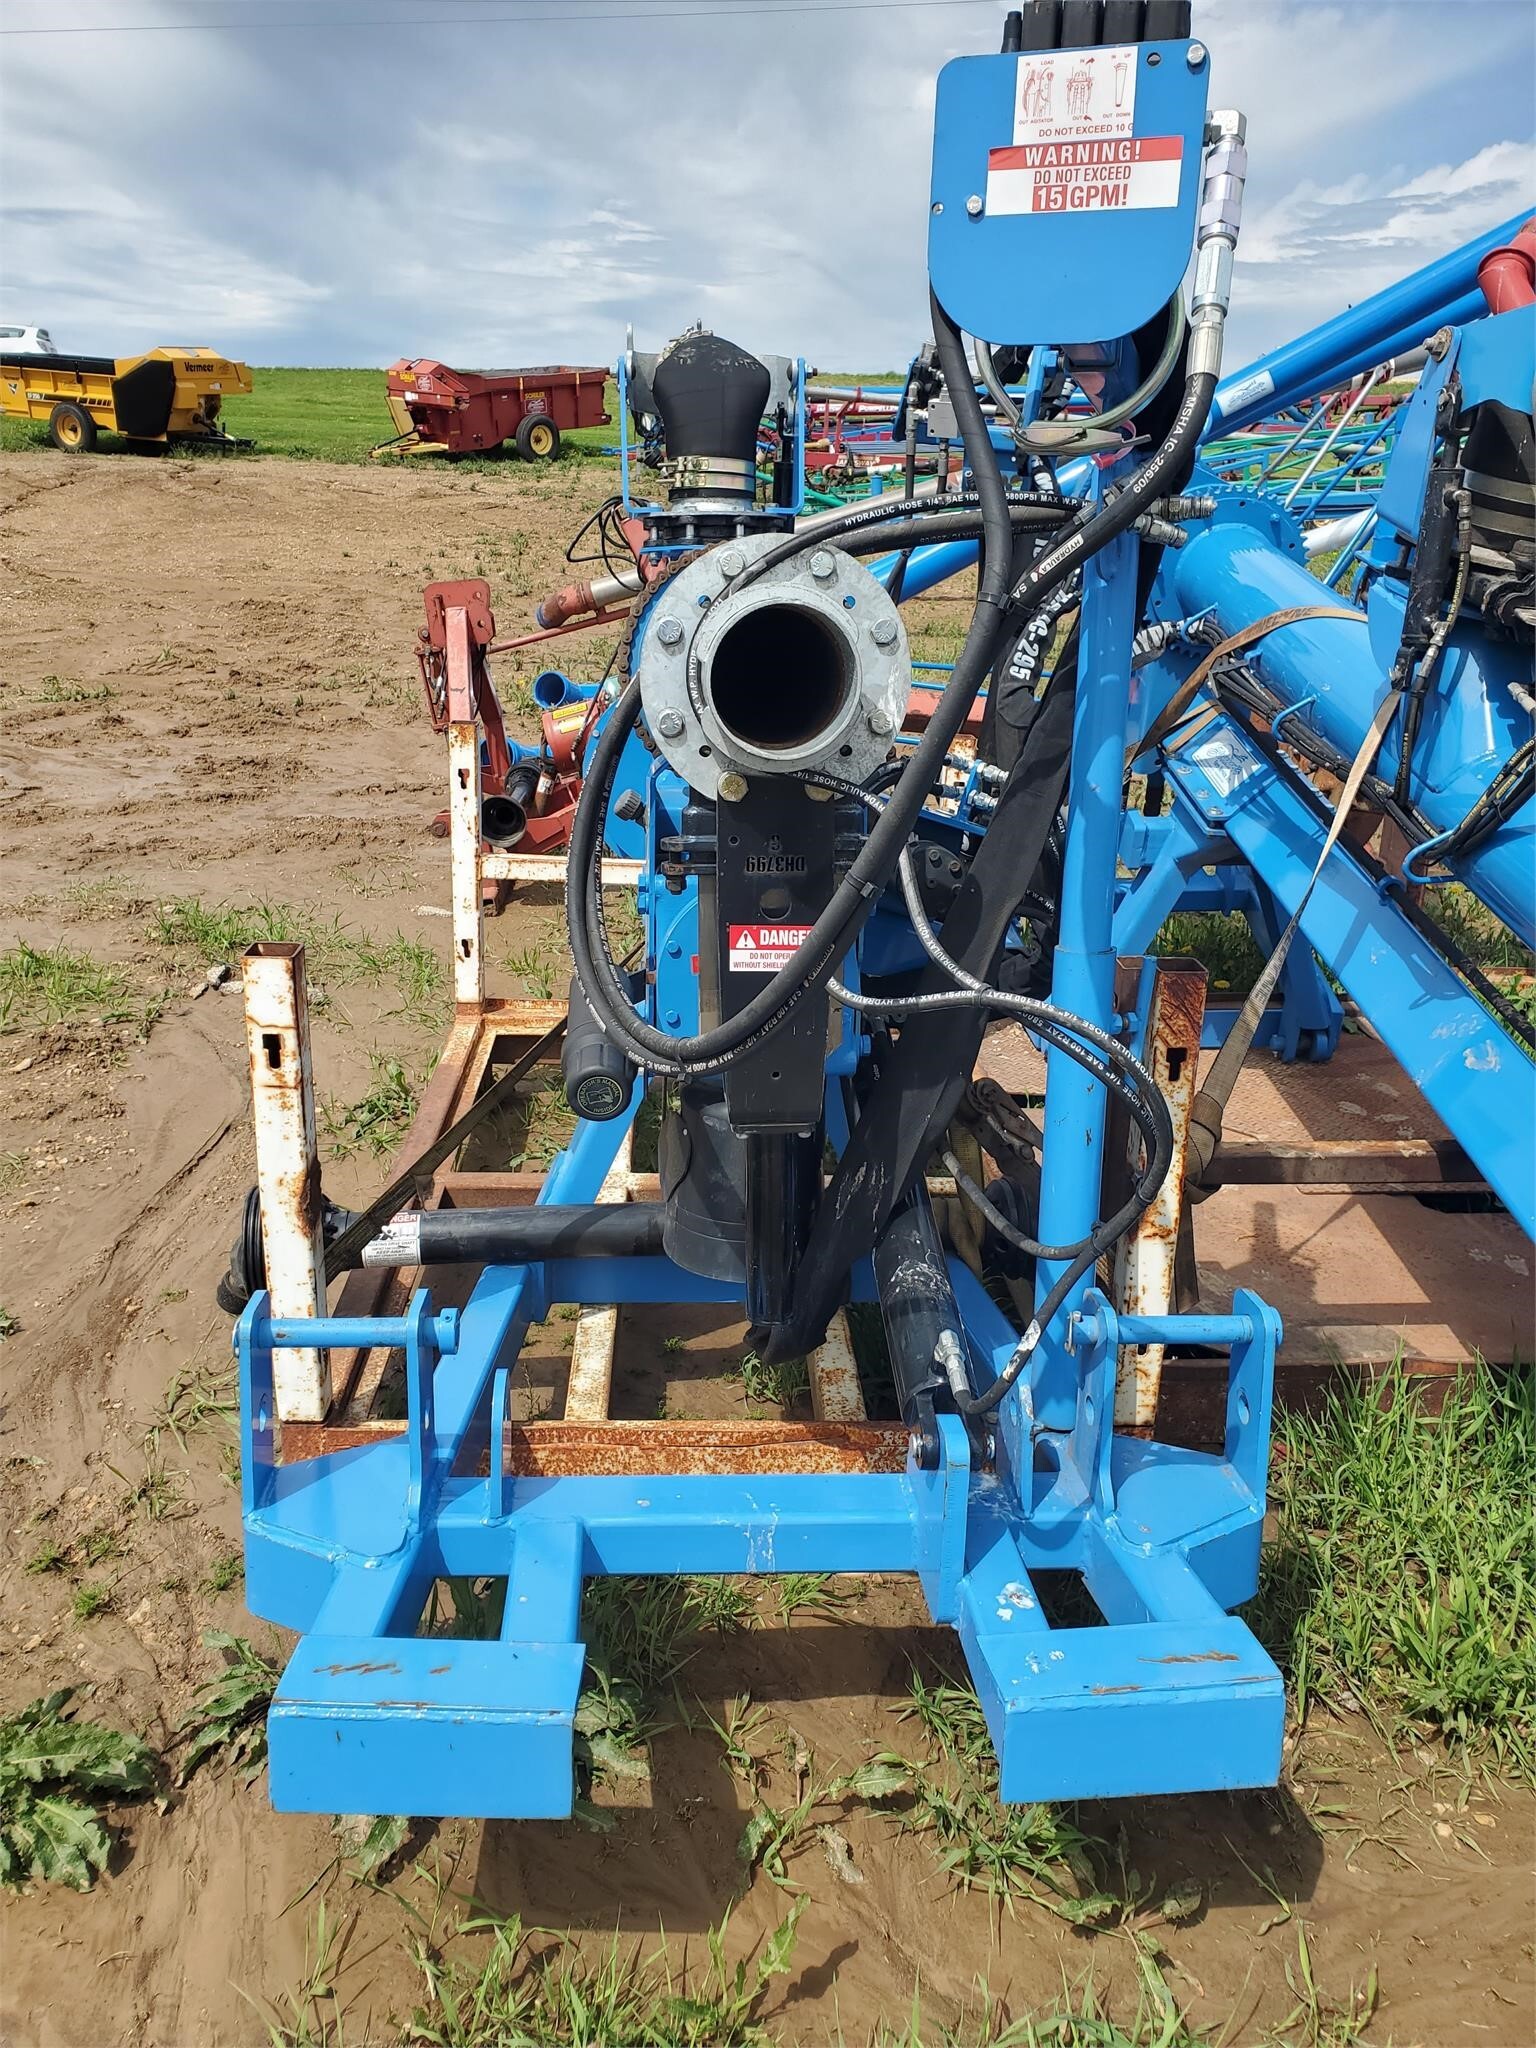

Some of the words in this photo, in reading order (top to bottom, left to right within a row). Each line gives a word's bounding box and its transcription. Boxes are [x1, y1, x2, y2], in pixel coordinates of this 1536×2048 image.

[1039, 129, 1052, 137] DO
[1054, 127, 1074, 136] NOT
[1076, 124, 1112, 134] EXCEED
[1116, 123, 1125, 132] 10
[1025, 140, 1142, 167] WARNING!
[1034, 170, 1050, 184] DO
[1056, 168, 1081, 183] NOT
[1084, 166, 1132, 182] EXCEED
[1036, 186, 1063, 210] 15
[1070, 184, 1129, 208] GPM!
[184, 362, 214, 373] Vermeer
[1173, 396, 1197, 435] MSHA
[1164, 438, 1178, 452] IC
[1133, 453, 1165, 494] -256/09
[1005, 492, 1038, 502] 5800PSI
[1041, 494, 1059, 504] MAX
[1062, 497, 1078, 507] W.P.
[844, 506, 896, 526] HYDRAULIC
[898, 500, 924, 516] HOSE
[946, 494, 964, 504] SAE
[965, 494, 980, 502] 100
[1034, 538, 1082, 580] HYDRAULAX
[1012, 582, 1028, 600] SA
[690, 679, 699, 700] W.P.
[793, 772, 809, 780] 1/4"
[814, 774, 838, 788] HOSE
[840, 783, 886, 812] HYDRAULIC
[745, 856, 806, 874] DH3799
[760, 930, 811, 946] DANGE
[918, 922, 930, 940] 4021
[927, 938, 964, 978] HYDRAULAX
[840, 987, 894, 1005] HYDRAULAX
[900, 997, 917, 1005] W.P.
[920, 993, 942, 1002] MAX
[944, 990, 977, 998] 00PSI
[986, 991, 1012, 1001] R2AT
[1014, 994, 1032, 1004] 100
[778, 1006, 789, 1020] 100
[1033, 998, 1057, 1012] SAE
[1058, 1010, 1078, 1022] 1/4"
[760, 1018, 778, 1036] R2AT
[1046, 1024, 1072, 1046] R2AT
[1082, 1018, 1110, 1040] HOSE
[1070, 1042, 1086, 1054] 100
[708, 1060, 719, 1069] WP
[720, 1051, 734, 1064] MAX
[1084, 1053, 1104, 1070] SAE
[1111, 1038, 1154, 1084] HYDRAULIC
[654, 1062, 672, 1073] MSHA
[693, 1062, 706, 1072] 4000
[1106, 1071, 1122, 1086] 1/4"
[602, 1080, 620, 1098] MANUAL
[1122, 1085, 1142, 1106] HOSE
[594, 1104, 614, 1113] INSIDE
